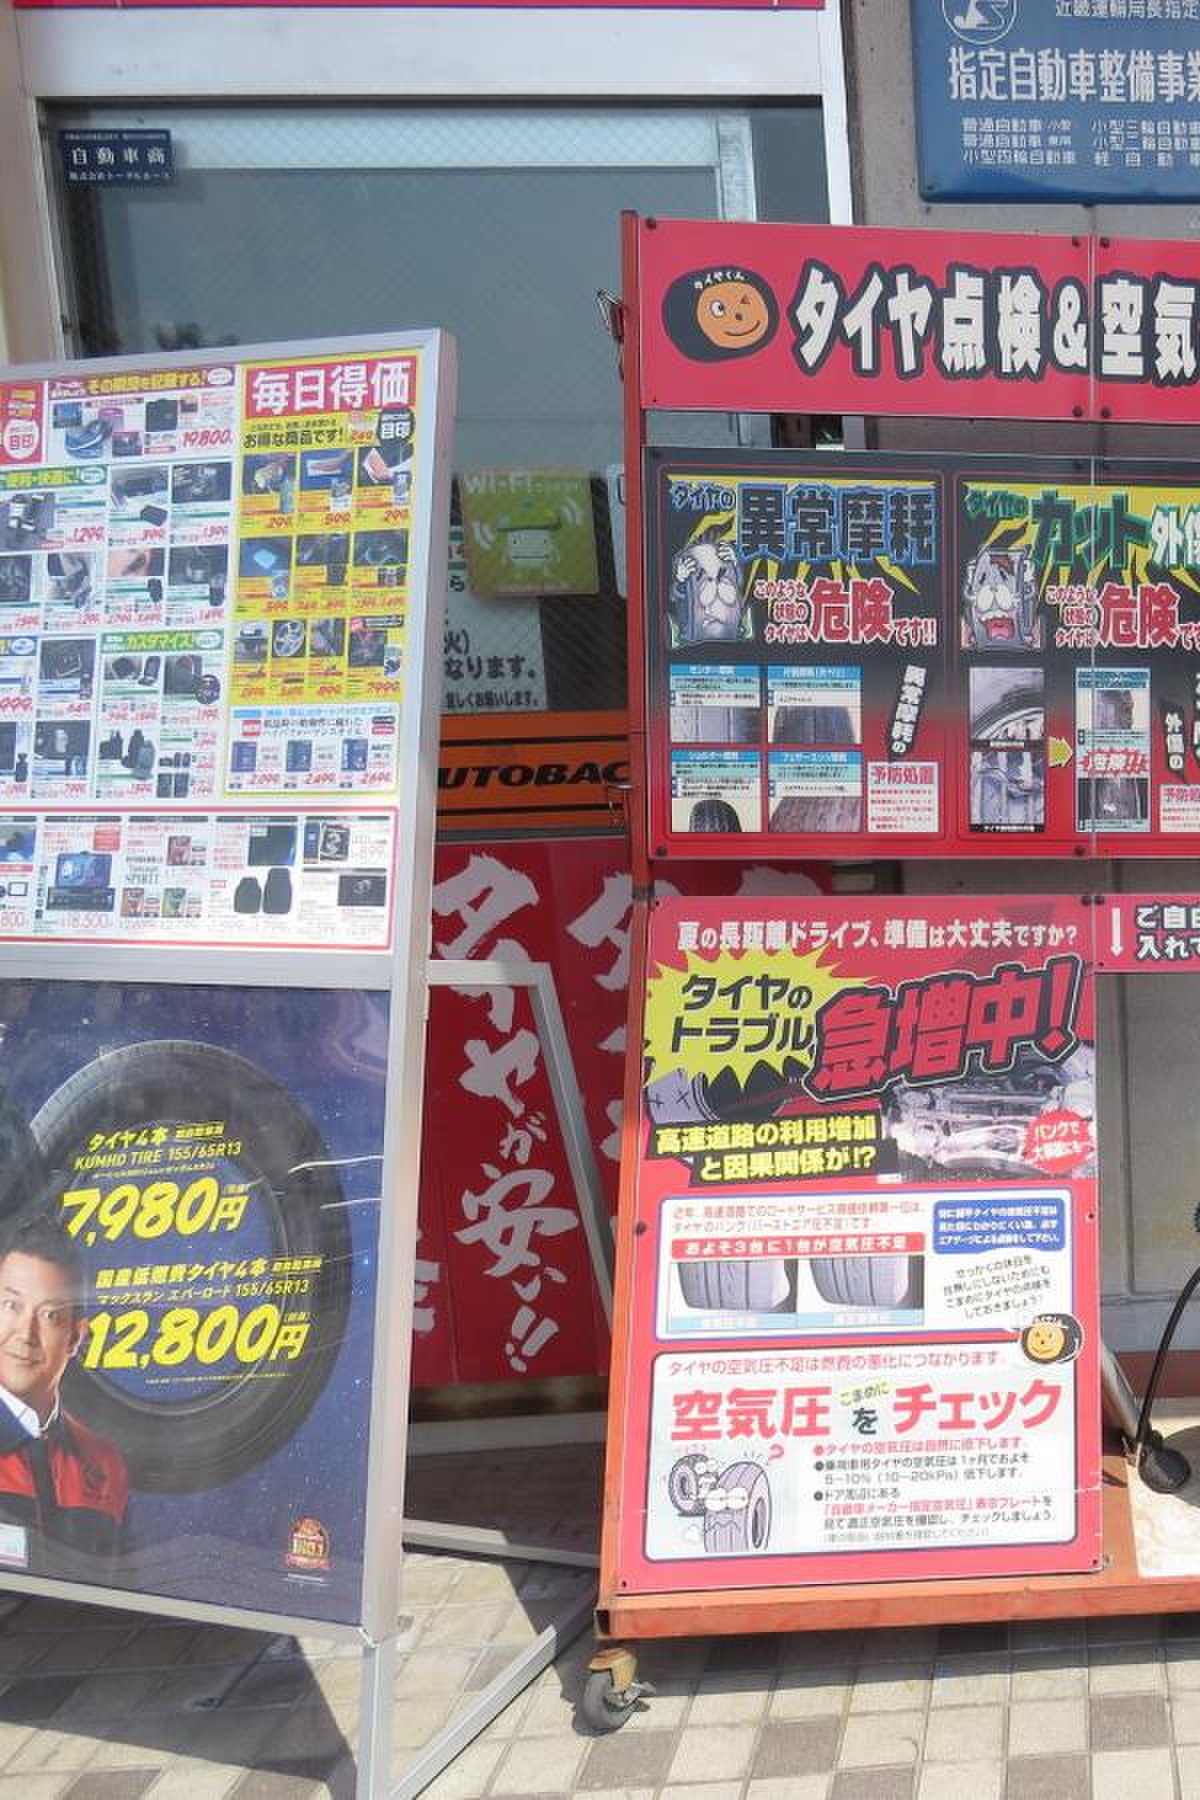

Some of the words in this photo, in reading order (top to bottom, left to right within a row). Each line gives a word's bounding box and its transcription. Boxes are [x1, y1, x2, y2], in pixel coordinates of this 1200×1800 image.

[72, 147, 165, 166] 自動車商
[252, 361, 412, 415] 毎日得価
[736, 482, 937, 565] 異常摩耗
[809, 576, 937, 648] 危険です!!
[444, 655, 537, 681] なります。
[677, 918, 1078, 950] 夏の長距離ドライブ、準備は大丈夫ですか?
[681, 973, 813, 1011] タイヤの
[671, 1016, 815, 1053] トラブル
[809, 956, 1081, 1098] 急増中!
[656, 1114, 877, 1154] 高速道路の利用増加
[74, 1153, 128, 1171] KUMHO
[131, 1150, 162, 1166] TIRE
[700, 1144, 876, 1180] と因果関係が!?
[63, 1176, 249, 1247] 7,980円
[83, 1303, 311, 1371] 12,800円
[671, 1386, 833, 1441] 空気圧
[852, 1407, 879, 1435] を
[893, 1378, 1062, 1434] チェック
